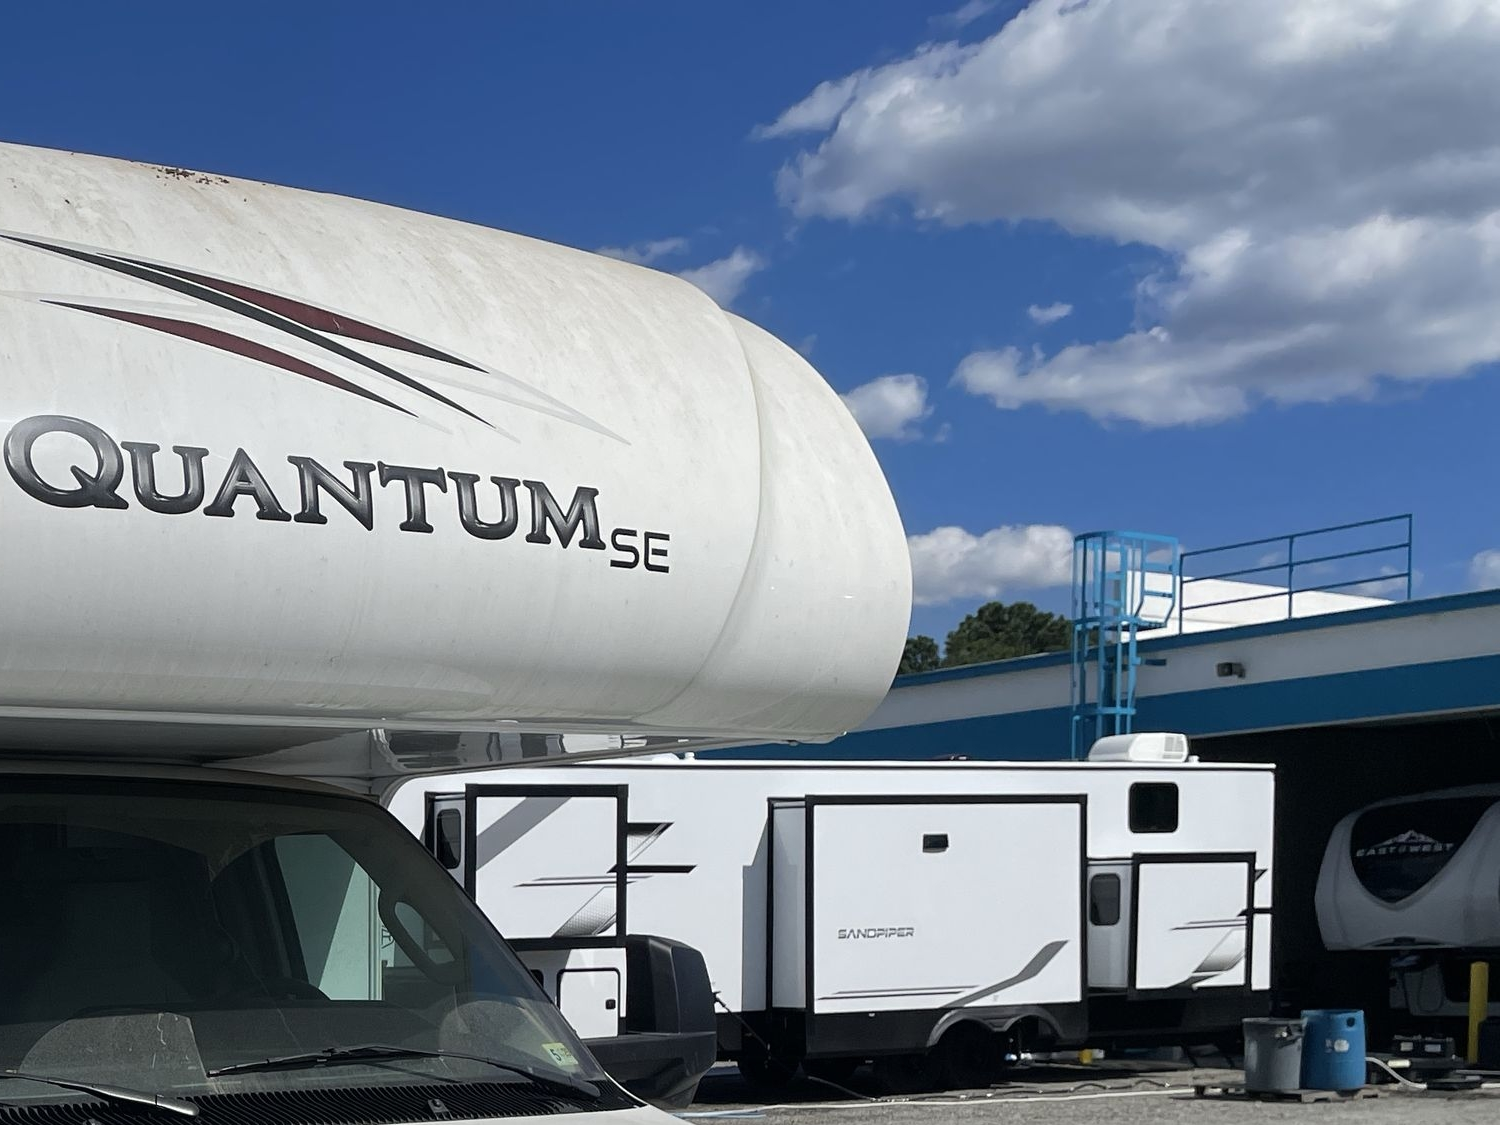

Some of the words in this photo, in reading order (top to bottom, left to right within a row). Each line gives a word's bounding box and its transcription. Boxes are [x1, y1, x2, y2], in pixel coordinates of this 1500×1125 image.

[3, 413, 607, 551] QUANTUM
[610, 528, 671, 574] SE
[837, 926, 915, 940] SANDPIPER
